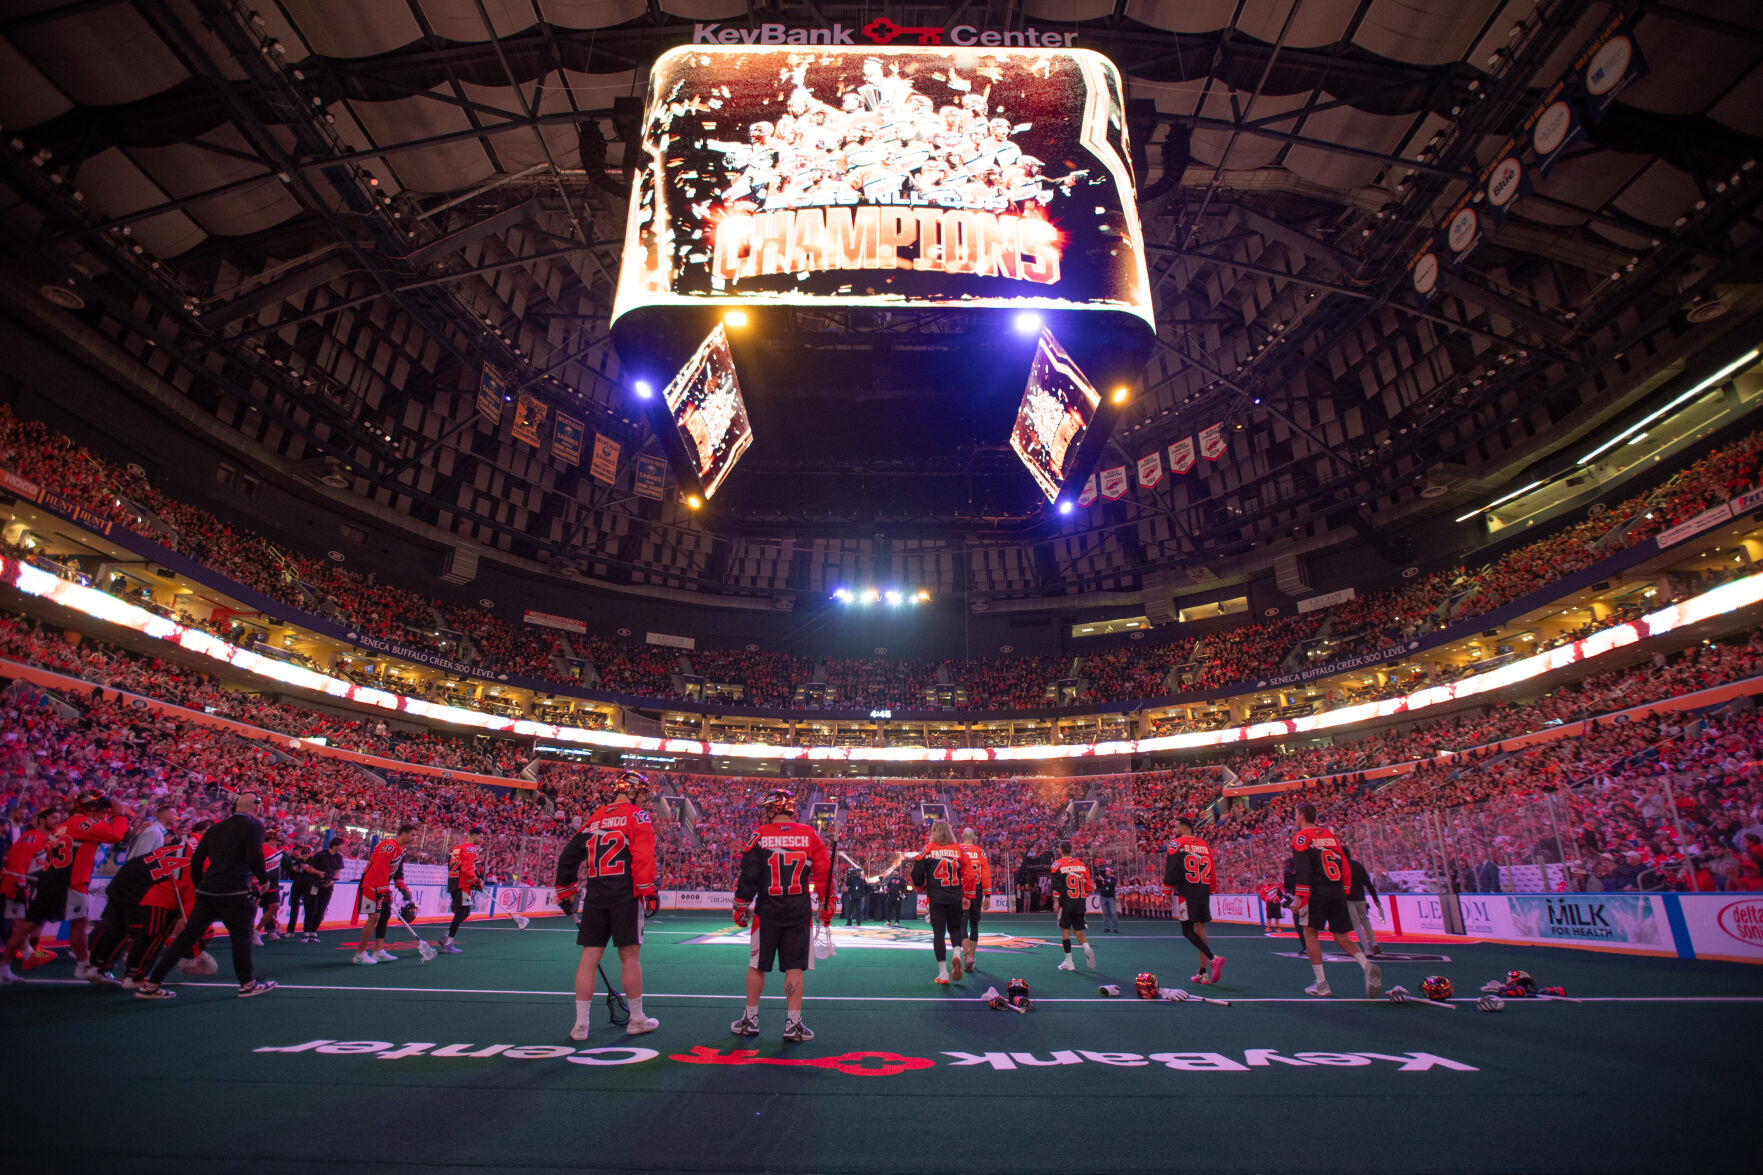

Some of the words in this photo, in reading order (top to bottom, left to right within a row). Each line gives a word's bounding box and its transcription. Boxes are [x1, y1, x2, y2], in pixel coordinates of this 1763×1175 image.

[693, 23, 855, 45] KeyBank
[950, 25, 1078, 48] Center
[1493, 170, 1514, 197] Blue
[712, 206, 1062, 286] CHAMPIONS
[5, 474, 37, 495] NOCO
[45, 493, 73, 513] HUNT
[80, 510, 106, 528] HUNT
[360, 635, 389, 652] SENECA
[392, 645, 428, 662] BUFFALO
[429, 656, 453, 669] CREEK
[454, 663, 470, 673] 300
[472, 667, 495, 679] LEVEL
[1270, 674, 1300, 686] SENECA
[1302, 664, 1335, 679] BUFFALO
[1337, 658, 1363, 671] CREEK
[1363, 652, 1381, 664] 300
[1383, 645, 1407, 658] LEVEL
[633, 810, 650, 824] 12
[380, 844, 394, 853] 20
[761, 836, 809, 848] BENESCH
[1297, 835, 1306, 845] 6
[144, 844, 192, 881] 44
[586, 830, 625, 878] 12
[931, 849, 960, 858] FARRELL
[1321, 849, 1342, 881] 6
[768, 851, 807, 896] 17
[933, 858, 960, 887] 41
[1184, 855, 1212, 884] 92
[1066, 873, 1090, 899] 91
[1546, 898, 1609, 926] MILK
[1551, 926, 1570, 936] FOR
[1573, 927, 1614, 938] HEALTH
[252, 1038, 661, 1066] Center
[940, 1049, 1480, 1072] KeyBank
